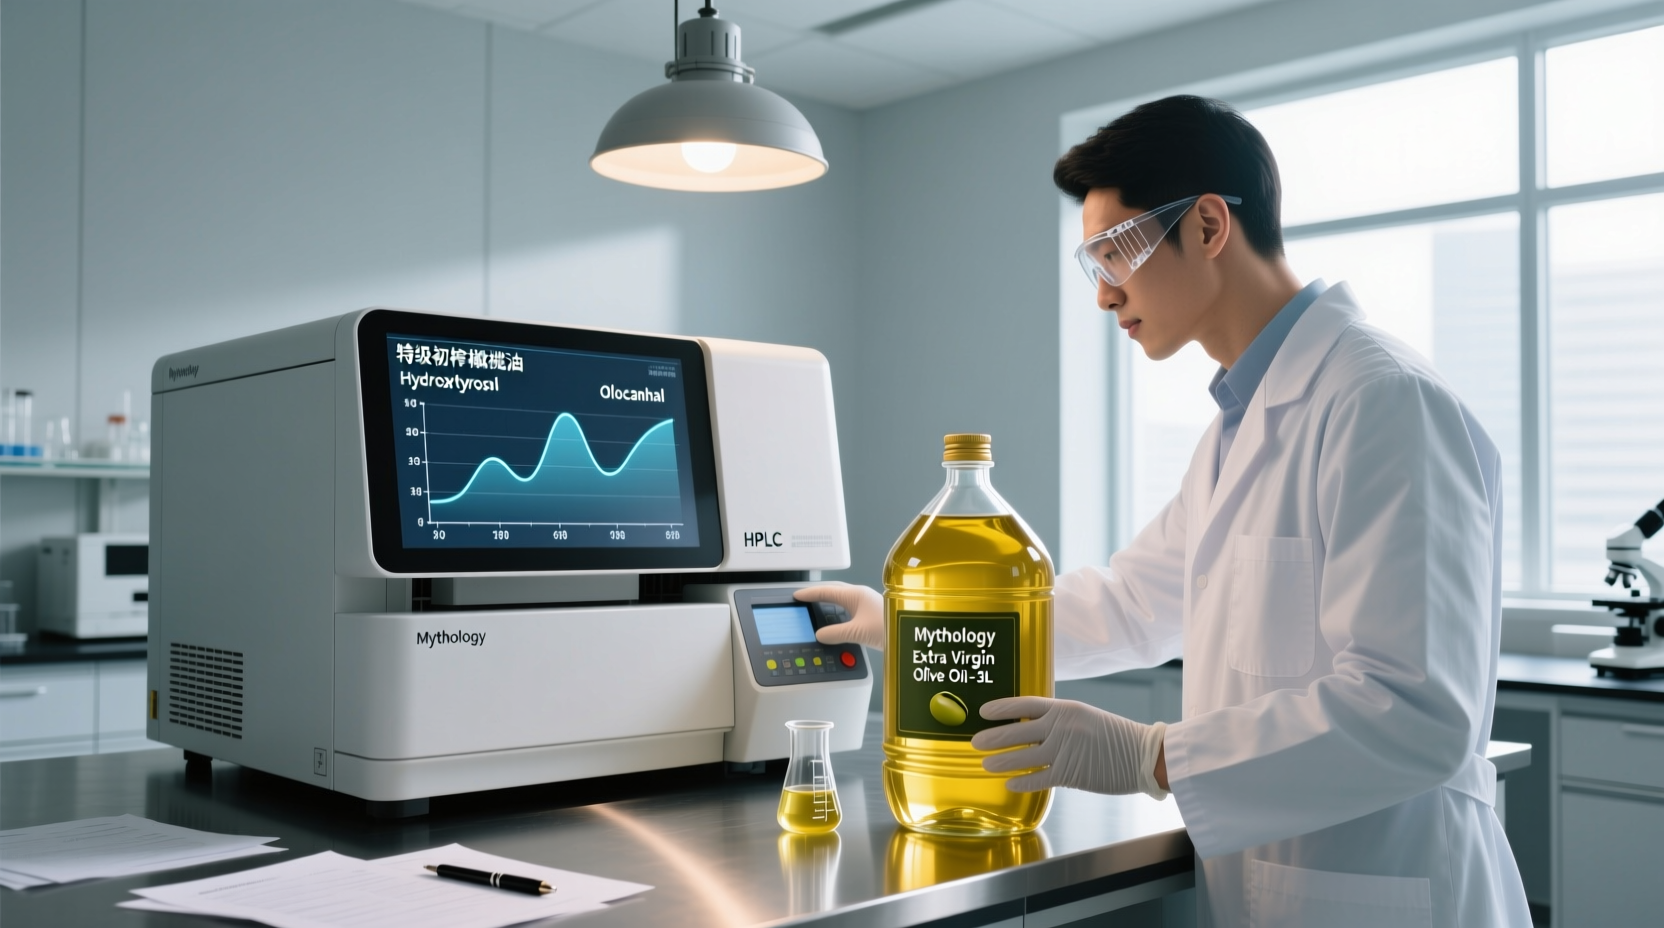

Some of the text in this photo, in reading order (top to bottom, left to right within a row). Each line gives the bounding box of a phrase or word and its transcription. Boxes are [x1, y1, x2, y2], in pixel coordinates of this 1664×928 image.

[744, 531, 783, 547] HPLC
[416, 629, 486, 649] Mythology
[914, 626, 996, 648] Mythology
[912, 649, 995, 670] Extra Virgin
